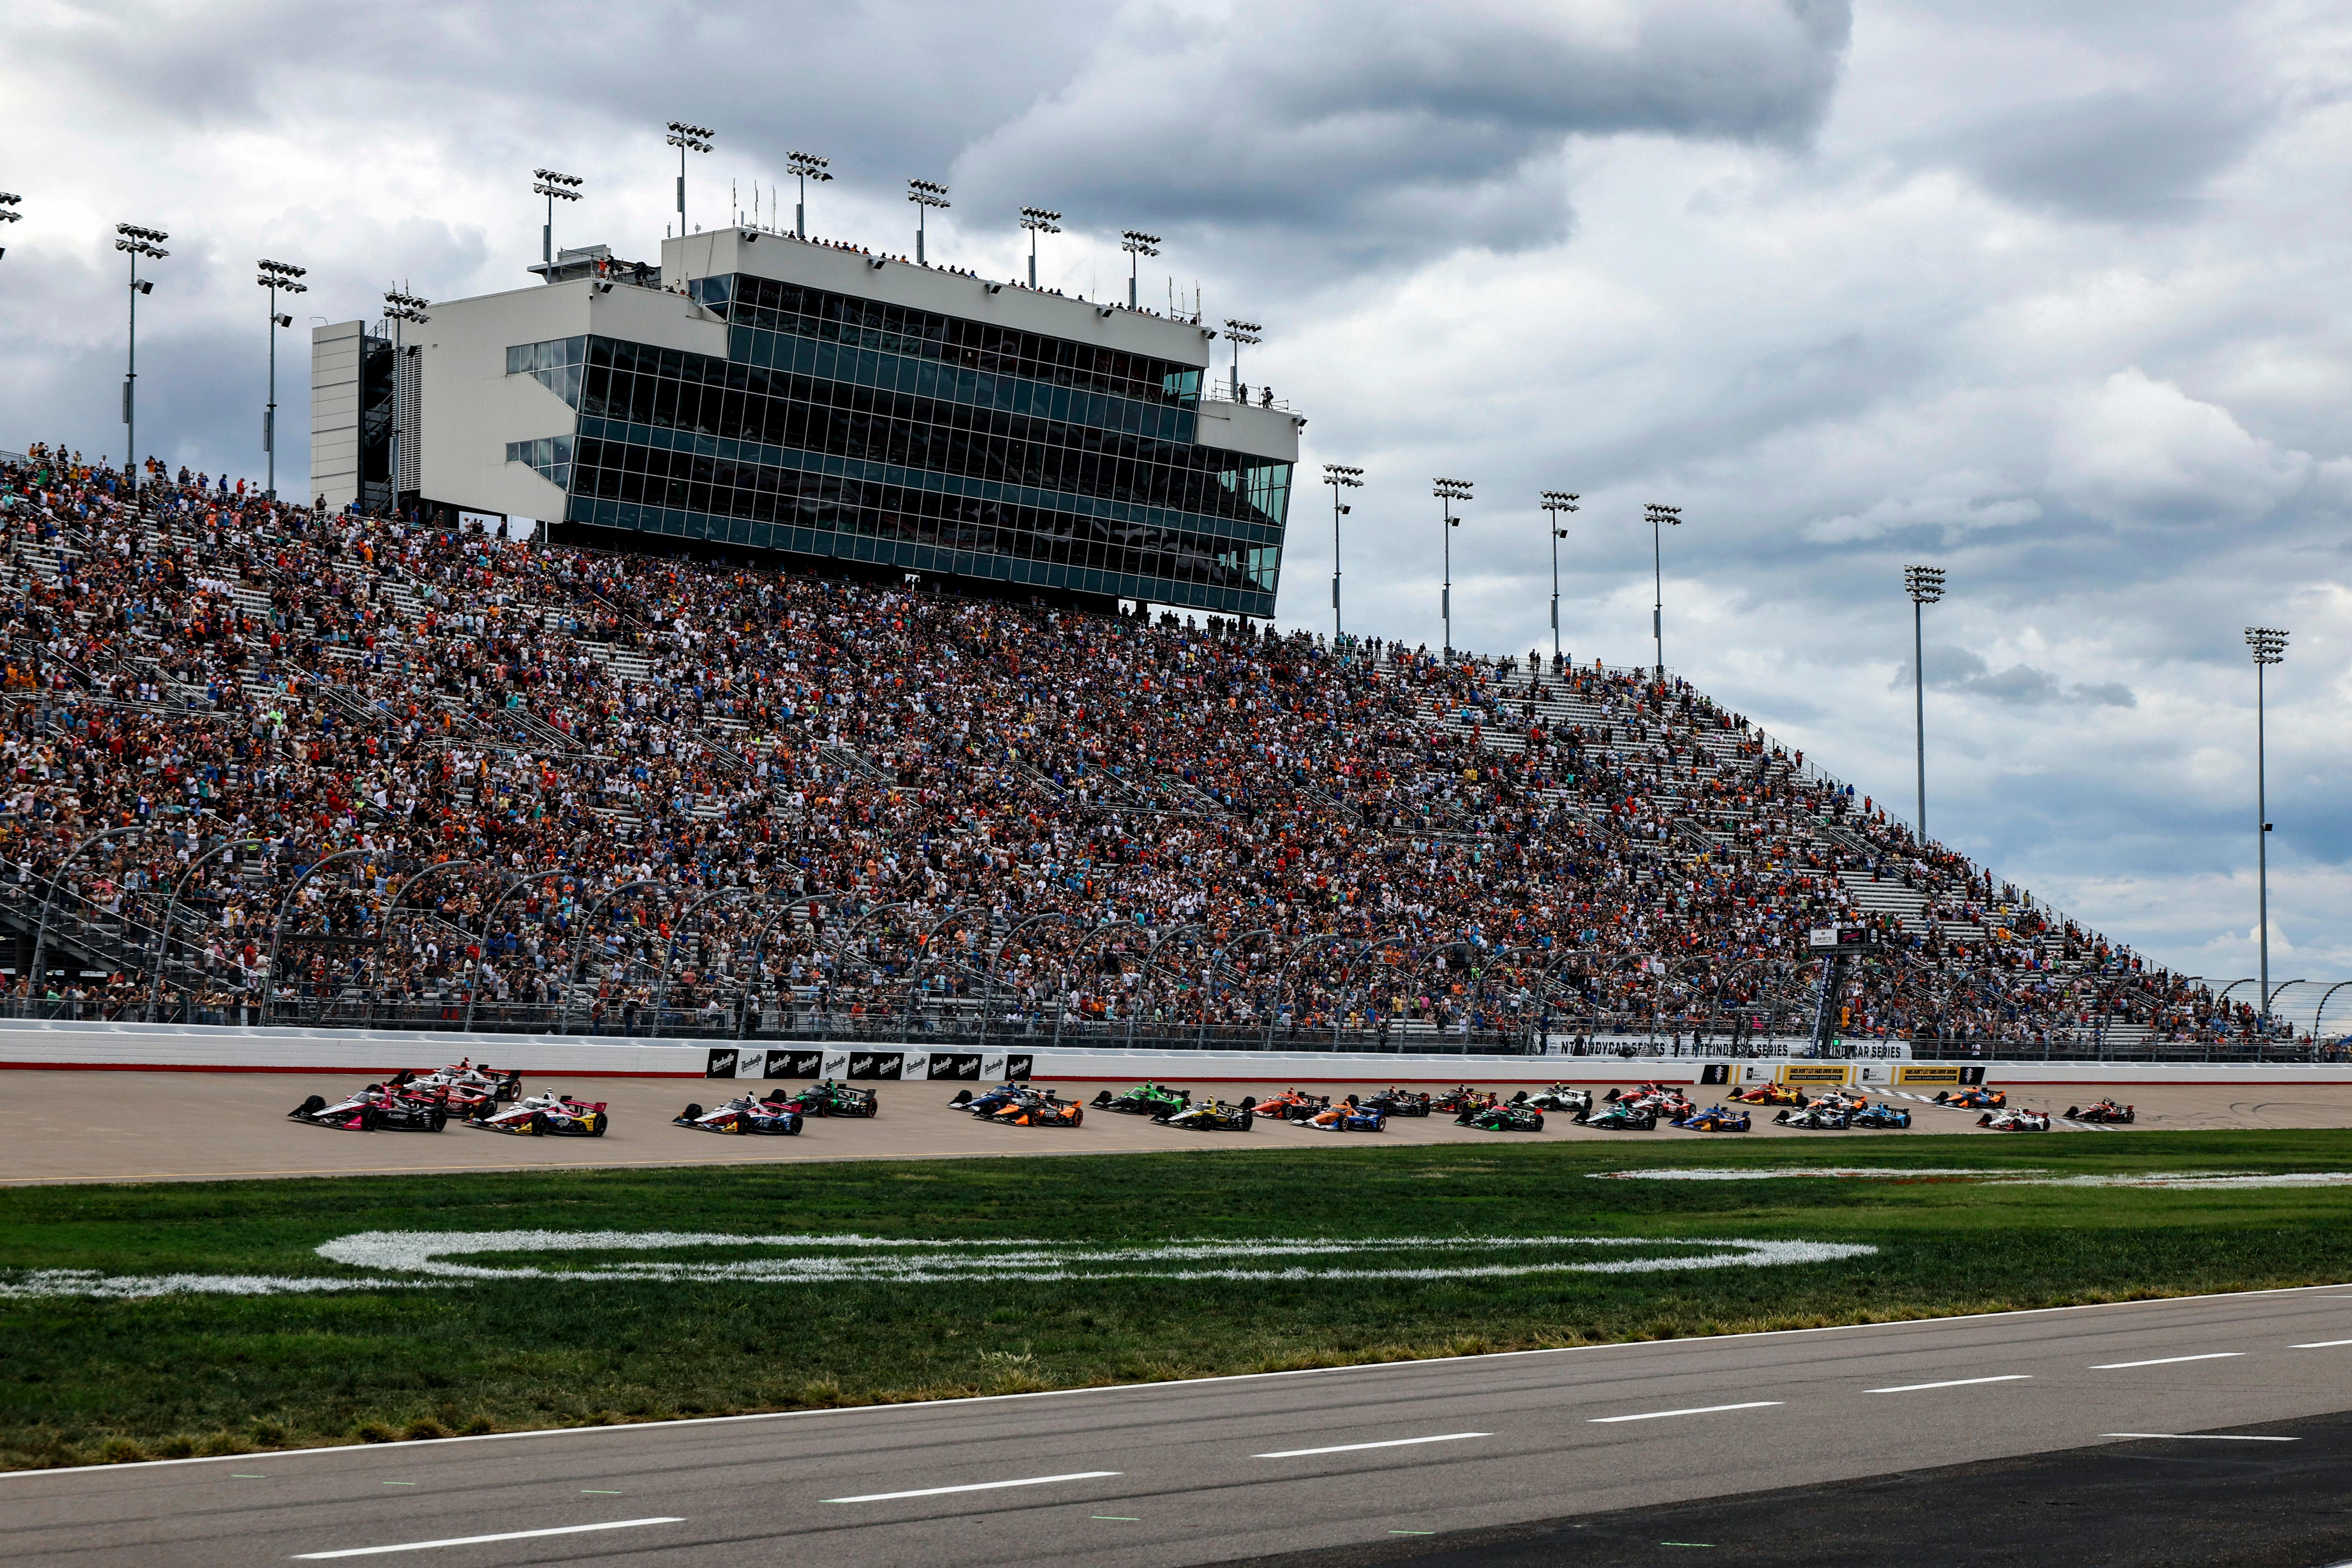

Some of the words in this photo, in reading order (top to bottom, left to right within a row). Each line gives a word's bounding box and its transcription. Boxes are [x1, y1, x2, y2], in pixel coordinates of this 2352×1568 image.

[1820, 958, 1830, 998] NASHVILLE
[1810, 998, 1824, 1055] SUPERSPEEDWAY
[1561, 1041, 1576, 1054] NT
[1757, 1044, 1788, 1056] SERIES
[1872, 1046, 1901, 1058] SERIES
